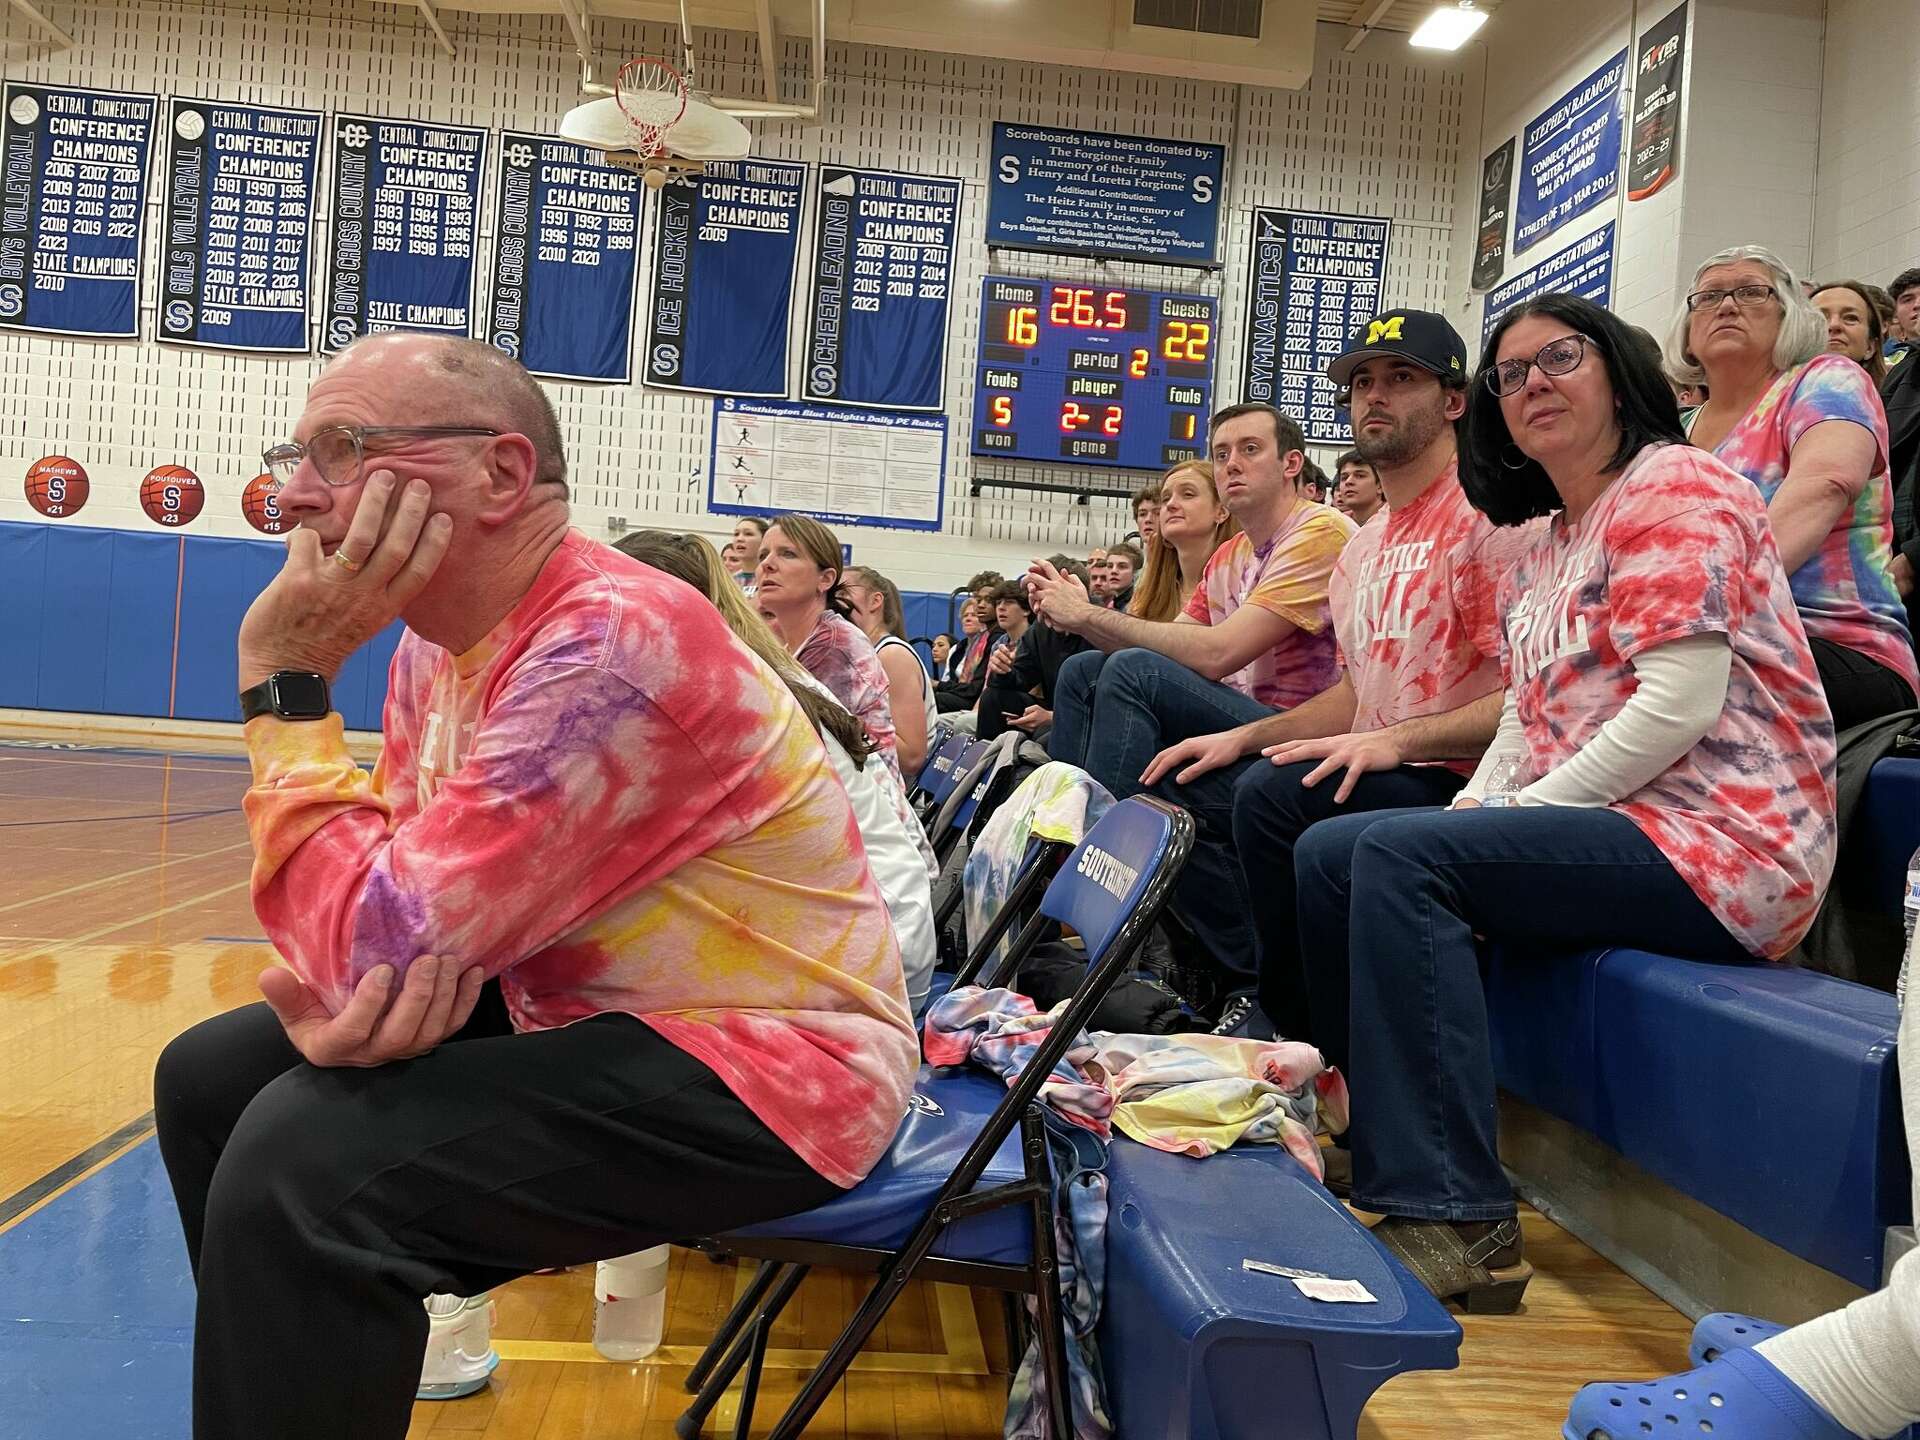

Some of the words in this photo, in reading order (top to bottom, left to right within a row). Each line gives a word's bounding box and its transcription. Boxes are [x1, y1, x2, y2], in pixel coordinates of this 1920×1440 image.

[47, 94, 86, 115] CENTRAL
[92, 100, 150, 120] CONNECTICUT
[1528, 101, 1574, 146] STEPHEN
[1570, 64, 1622, 112] BARMORE
[50, 118, 145, 142] CONFERENCE
[212, 110, 252, 131] CENTRAL
[258, 116, 317, 137] CONNECTICUT
[215, 132, 311, 158] CONFERENCE
[378, 126, 418, 145] CENTRAL
[423, 131, 478, 152] CONNECTICUT
[1006, 128, 1080, 145] Scoreboards
[1083, 136, 1111, 148] have
[1114, 140, 1142, 151] been
[1145, 143, 1192, 157] donated
[1195, 147, 1213, 160] by:
[1532, 131, 1581, 176] CONNECTICUT
[1581, 112, 1609, 141] SPORTS
[53, 140, 138, 164] CHAMPIONS
[380, 146, 475, 171] CONFERENCE
[541, 144, 580, 165] CENTRAL
[1049, 146, 1071, 157] The
[1074, 148, 1125, 163] Forgione
[1128, 154, 1167, 168] Family
[1536, 160, 1565, 187] WRITERS
[1567, 134, 1600, 167] ALLIANCE
[220, 156, 304, 179] CHAMPIONS
[385, 167, 468, 192] CHAMPIONS
[541, 166, 637, 192] CONFERENCE
[745, 166, 801, 186] CONNECTICUT
[999, 156, 1020, 184] S
[1032, 156, 1043, 166] in
[1045, 159, 1092, 172] memory
[1097, 164, 1109, 172] of
[1111, 165, 1138, 176] their
[1141, 169, 1186, 182] parents;
[1538, 183, 1553, 200] HAL
[1570, 153, 1596, 180] AWARD
[2, 132, 34, 232] VOLLEYBALL
[341, 150, 366, 218] COUNTRY
[860, 178, 896, 198] CENTRAL
[902, 183, 955, 203] CONNECTICUT
[1028, 168, 1063, 181] Henry
[1067, 172, 1089, 182] and
[1092, 174, 1131, 186] Loretta
[1135, 178, 1185, 193] Forgione
[1192, 175, 1213, 203] S
[172, 146, 200, 245] VOLLEYBALL
[375, 188, 405, 204] 1980
[410, 192, 439, 208] 1981
[445, 195, 473, 210] 1982
[503, 168, 530, 235] COUNTRY
[547, 189, 630, 213] CHAMPIONS
[702, 183, 797, 208] CONFERENCE
[1024, 194, 1045, 204] The
[1048, 196, 1076, 206] Heitz
[1078, 199, 1114, 211] Family
[1116, 203, 1127, 211] in
[1129, 204, 1170, 218] memory
[1174, 209, 1185, 217] of
[1055, 186, 1097, 197] Additional
[1099, 189, 1156, 202] Contributions:
[1518, 215, 1550, 240] ATHLETE
[1548, 206, 1557, 222] OF
[1559, 197, 1572, 214] THE
[1572, 184, 1590, 206] YEAR
[1592, 170, 1616, 193] 2013
[708, 206, 789, 228] CHAMPIONS
[860, 200, 952, 224] CONFERENCE
[1052, 207, 1089, 218] Francis
[1092, 210, 1103, 219] A.
[1106, 212, 1139, 223] Parise,
[1142, 215, 1156, 225] Sr.
[699, 226, 727, 242] 2009
[865, 222, 944, 244] CHAMPIONS
[1292, 219, 1328, 237] CENTRAL
[1332, 221, 1384, 241] CONNECTICUT
[337, 220, 363, 270] CROSS
[661, 196, 690, 292] HOCKEY
[1293, 238, 1381, 259] CONFERENCE
[1, 238, 26, 279] BOYS
[33, 252, 68, 272] STATE
[73, 256, 136, 276] CHAMPIONS
[500, 237, 524, 286] CROSS
[1297, 256, 1374, 277] CHAMPIONS
[1492, 270, 1537, 306] SPECTATOR
[1538, 231, 1605, 280] EXPECTATIONS
[35, 275, 64, 292] 2010
[169, 250, 195, 294] GIRLS
[816, 200, 849, 365] CHEERLEADING
[204, 286, 238, 305] STATE
[243, 289, 303, 308] CHAMPIONS
[334, 272, 360, 315] BOYS
[995, 283, 1033, 302] Home
[1291, 278, 1316, 292] 2002
[1321, 280, 1347, 294] 2003
[1352, 282, 1377, 295] 2005
[0, 283, 23, 317] S
[498, 287, 521, 330] GIRLS
[1050, 287, 1126, 329] 26.5
[1163, 300, 1210, 319] Guests
[164, 299, 194, 332] S
[368, 301, 402, 321] STATE
[407, 305, 466, 325] CHAMPIONS
[656, 297, 681, 336] ICE
[1250, 243, 1282, 400] GYMNASTICS
[328, 315, 358, 348] S
[1007, 307, 1038, 345] 16
[1366, 317, 1406, 345] M
[1164, 321, 1209, 360] 22
[652, 343, 680, 376] S
[1074, 353, 1118, 369] period
[1131, 349, 1149, 376] 2
[1282, 355, 1312, 371] STATE
[811, 364, 837, 398] S
[986, 370, 1018, 388] fouls
[1072, 379, 1116, 398] player
[724, 398, 734, 410] S
[1170, 388, 1201, 404] fouls
[739, 404, 800, 416] Southington
[802, 409, 824, 419] Blue
[827, 411, 865, 422] Knights
[867, 415, 893, 426] Daily
[911, 419, 944, 429] Rubric
[995, 397, 1012, 425] 5
[1187, 415, 1195, 438] 1
[985, 433, 1011, 447] won
[1073, 440, 1106, 455] game
[39, 466, 77, 476] MATHEWS
[150, 474, 197, 486] POUTOUVES
[48, 476, 66, 502] S
[162, 486, 180, 510] S
[1380, 541, 1435, 578] LIKE
